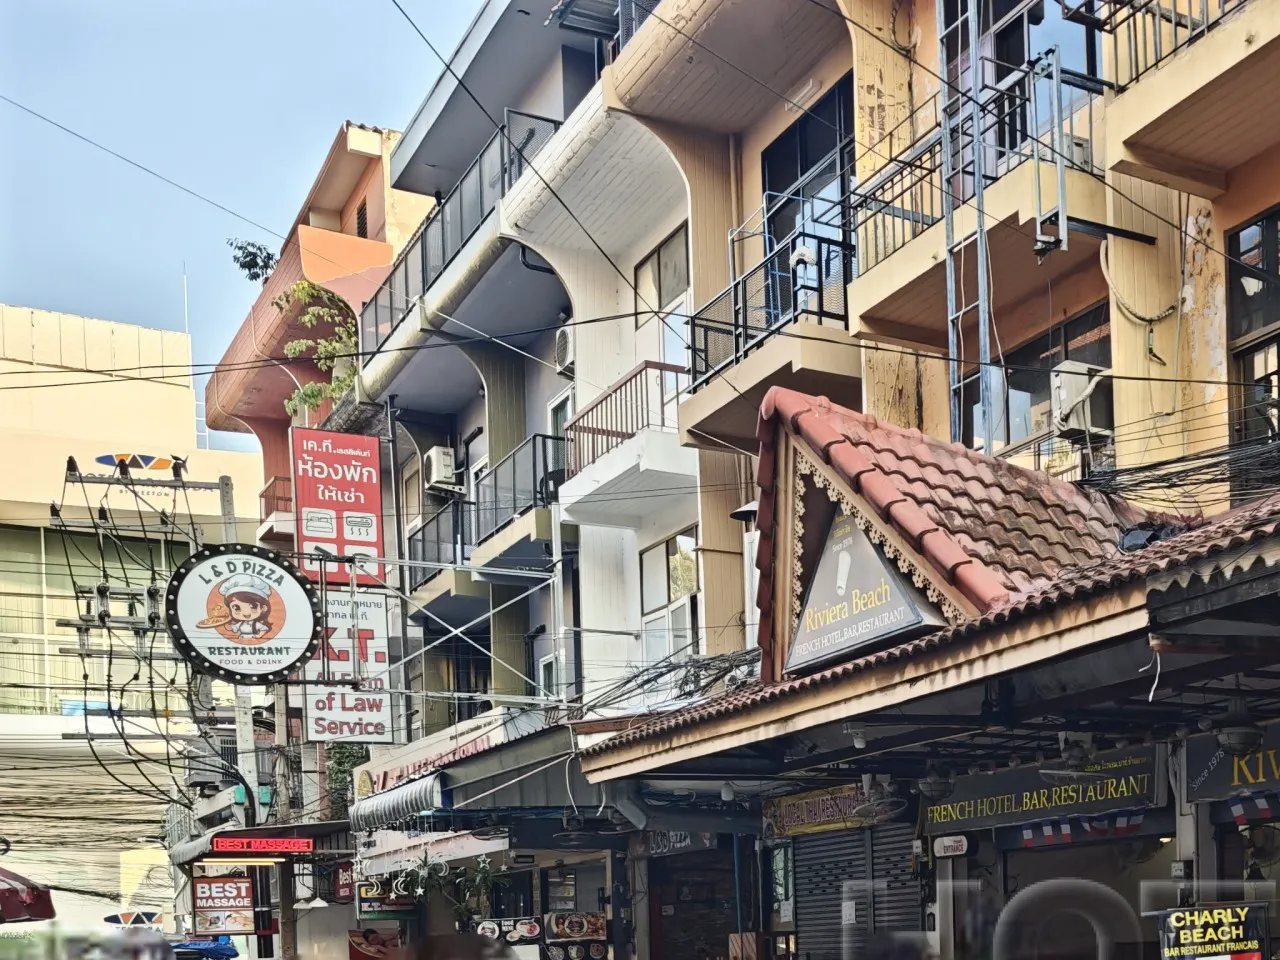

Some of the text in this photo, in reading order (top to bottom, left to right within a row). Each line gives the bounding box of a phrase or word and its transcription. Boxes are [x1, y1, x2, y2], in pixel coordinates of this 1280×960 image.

[298, 454, 377, 483] ห้องพัก
[317, 485, 364, 503] ให้เช่า
[198, 561, 285, 587] L & D PIZZA
[805, 578, 891, 634] Riviera Beach
[207, 645, 291, 656] RESTAURANT
[795, 636, 824, 657] FRENCH
[315, 692, 383, 712] of Law
[315, 717, 386, 736] Service
[1191, 769, 1209, 791] Since
[928, 800, 974, 824] FRENCH
[219, 840, 308, 850] BEST MASSAGE
[339, 867, 352, 885] Best
[197, 882, 231, 897] BEST
[197, 897, 251, 908] MASSAGE
[1170, 907, 1249, 927] CHARLY
[1180, 925, 1243, 944] BEACH
[1164, 940, 1259, 957] BAR RESTAURANT FRANCAIS
